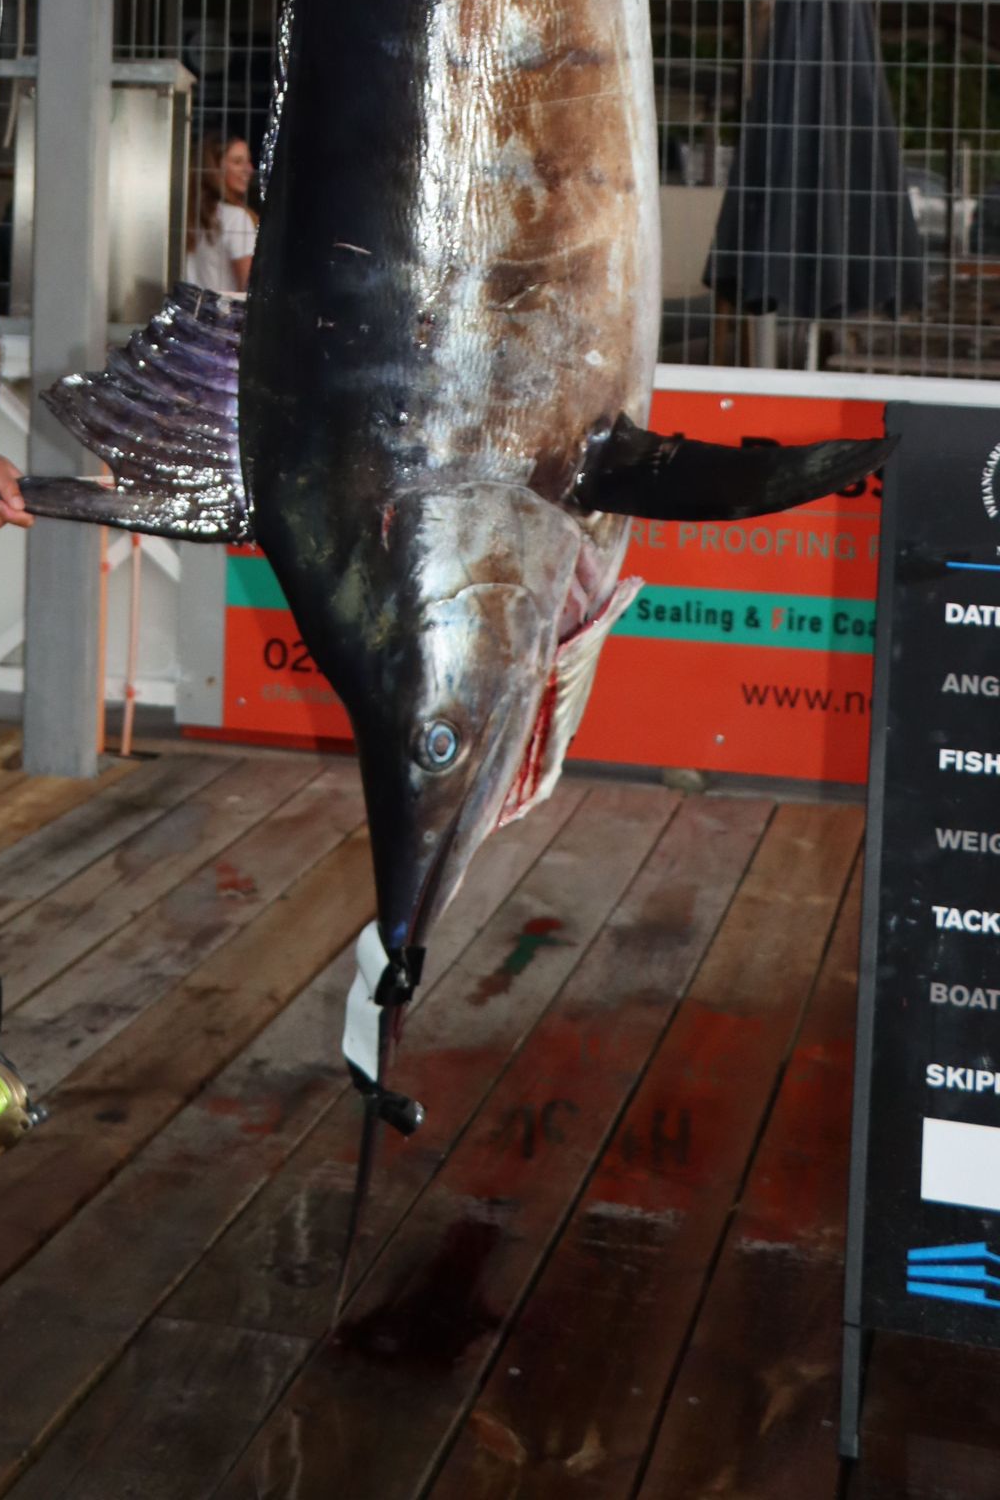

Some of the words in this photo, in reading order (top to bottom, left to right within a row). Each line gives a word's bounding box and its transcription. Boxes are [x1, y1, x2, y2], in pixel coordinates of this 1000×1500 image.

[679, 524, 857, 561] PROOFING
[637, 598, 735, 633] Sealing
[744, 605, 761, 629] &
[771, 606, 823, 634] Fire
[741, 683, 873, 714] www.n
[941, 673, 1000, 697] ANG
[939, 748, 1000, 774] FISH
[932, 905, 1000, 934] TACK
[930, 982, 1000, 1010] BOAT
